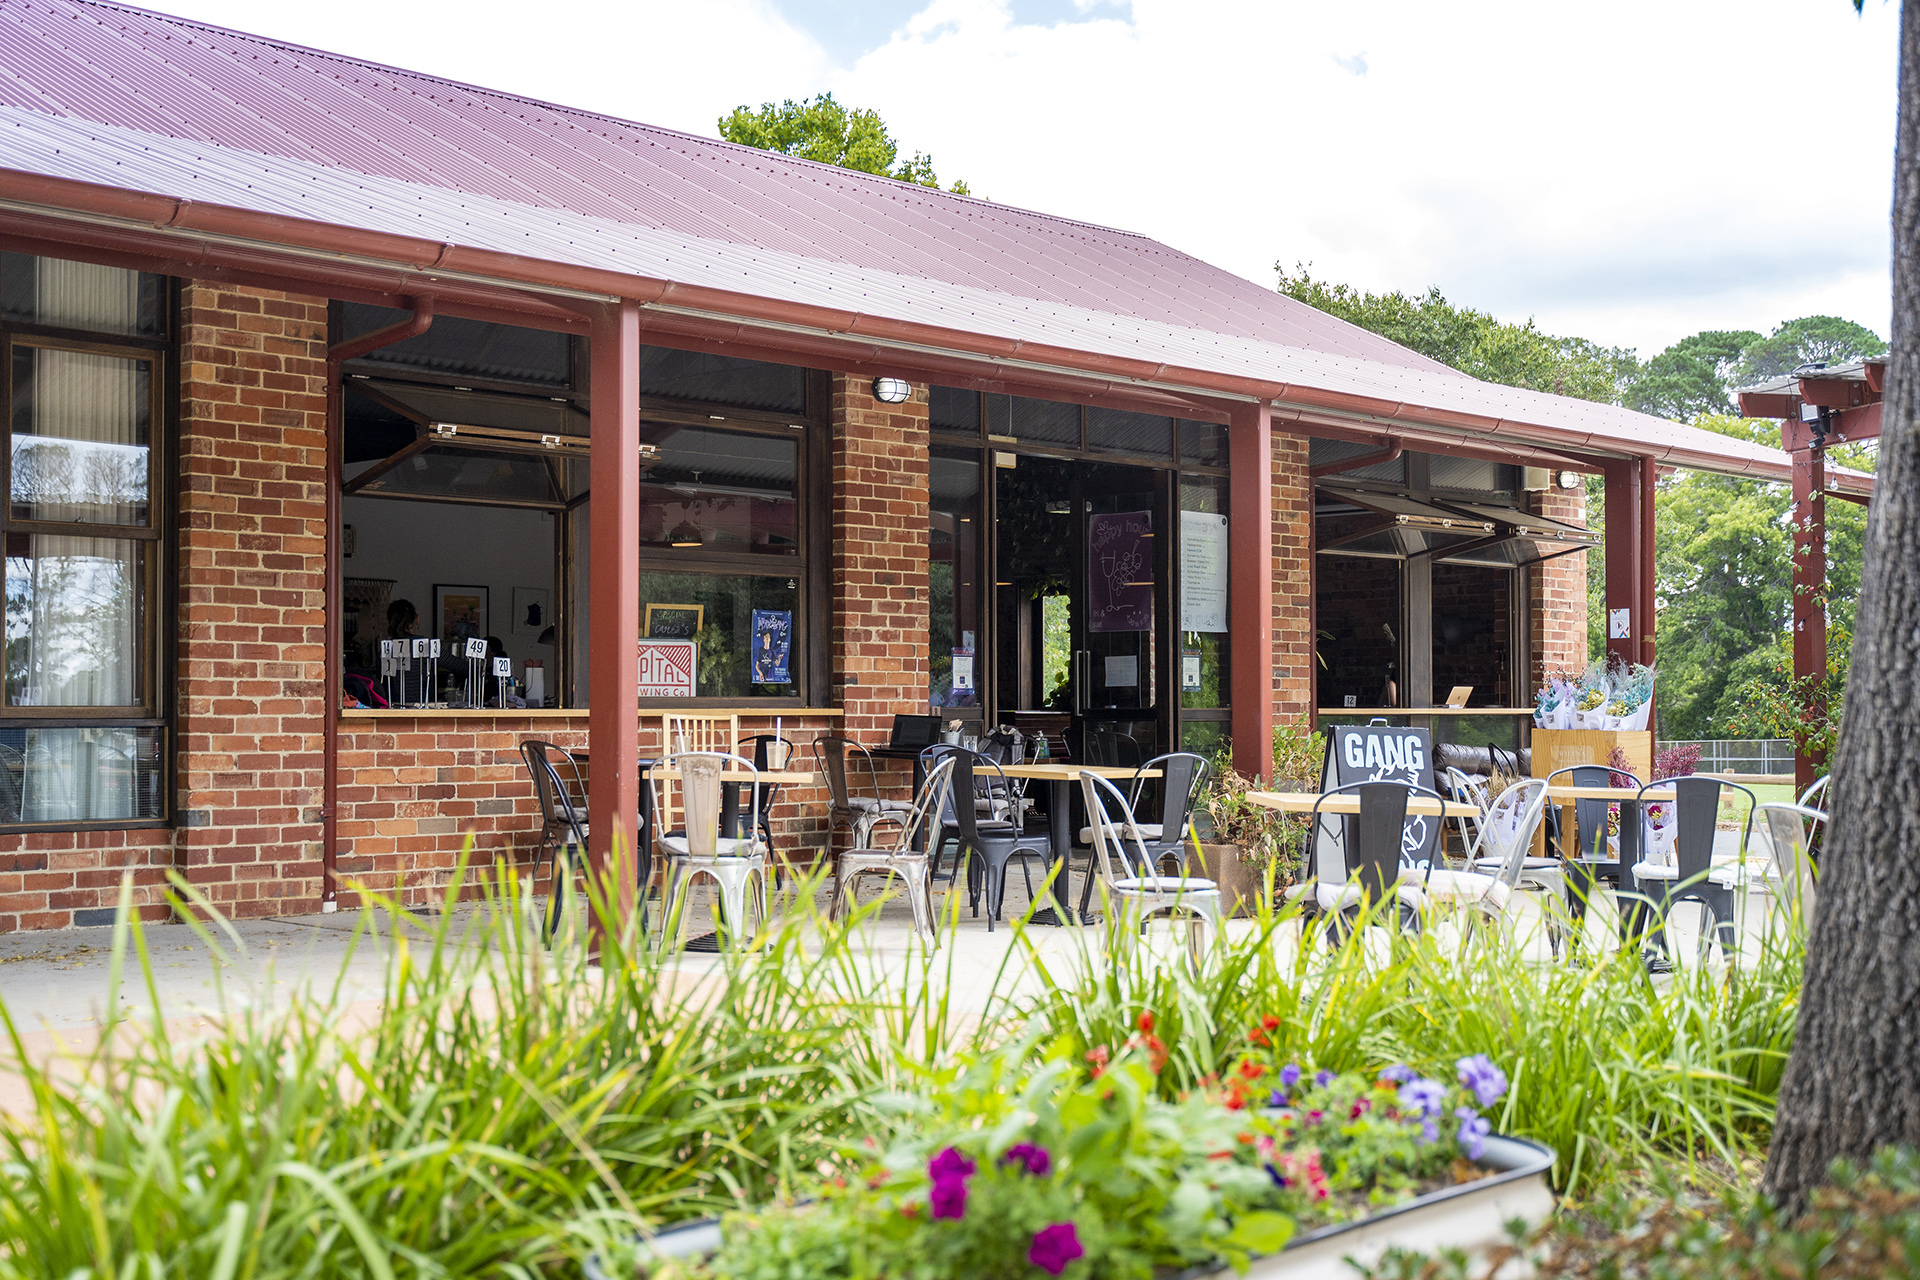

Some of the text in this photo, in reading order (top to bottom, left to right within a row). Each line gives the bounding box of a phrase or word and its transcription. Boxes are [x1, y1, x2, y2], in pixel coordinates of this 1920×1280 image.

[1092, 519, 1150, 552] happy hour
[398, 640, 404, 653] 7
[419, 641, 424, 653] 6
[433, 641, 438, 652] 3
[470, 640, 484, 653] 49
[498, 659, 509, 672] 20
[640, 650, 685, 683] PITAL
[640, 688, 669, 697] WING
[1347, 696, 1354, 704] 12
[1344, 733, 1425, 770] GANG
